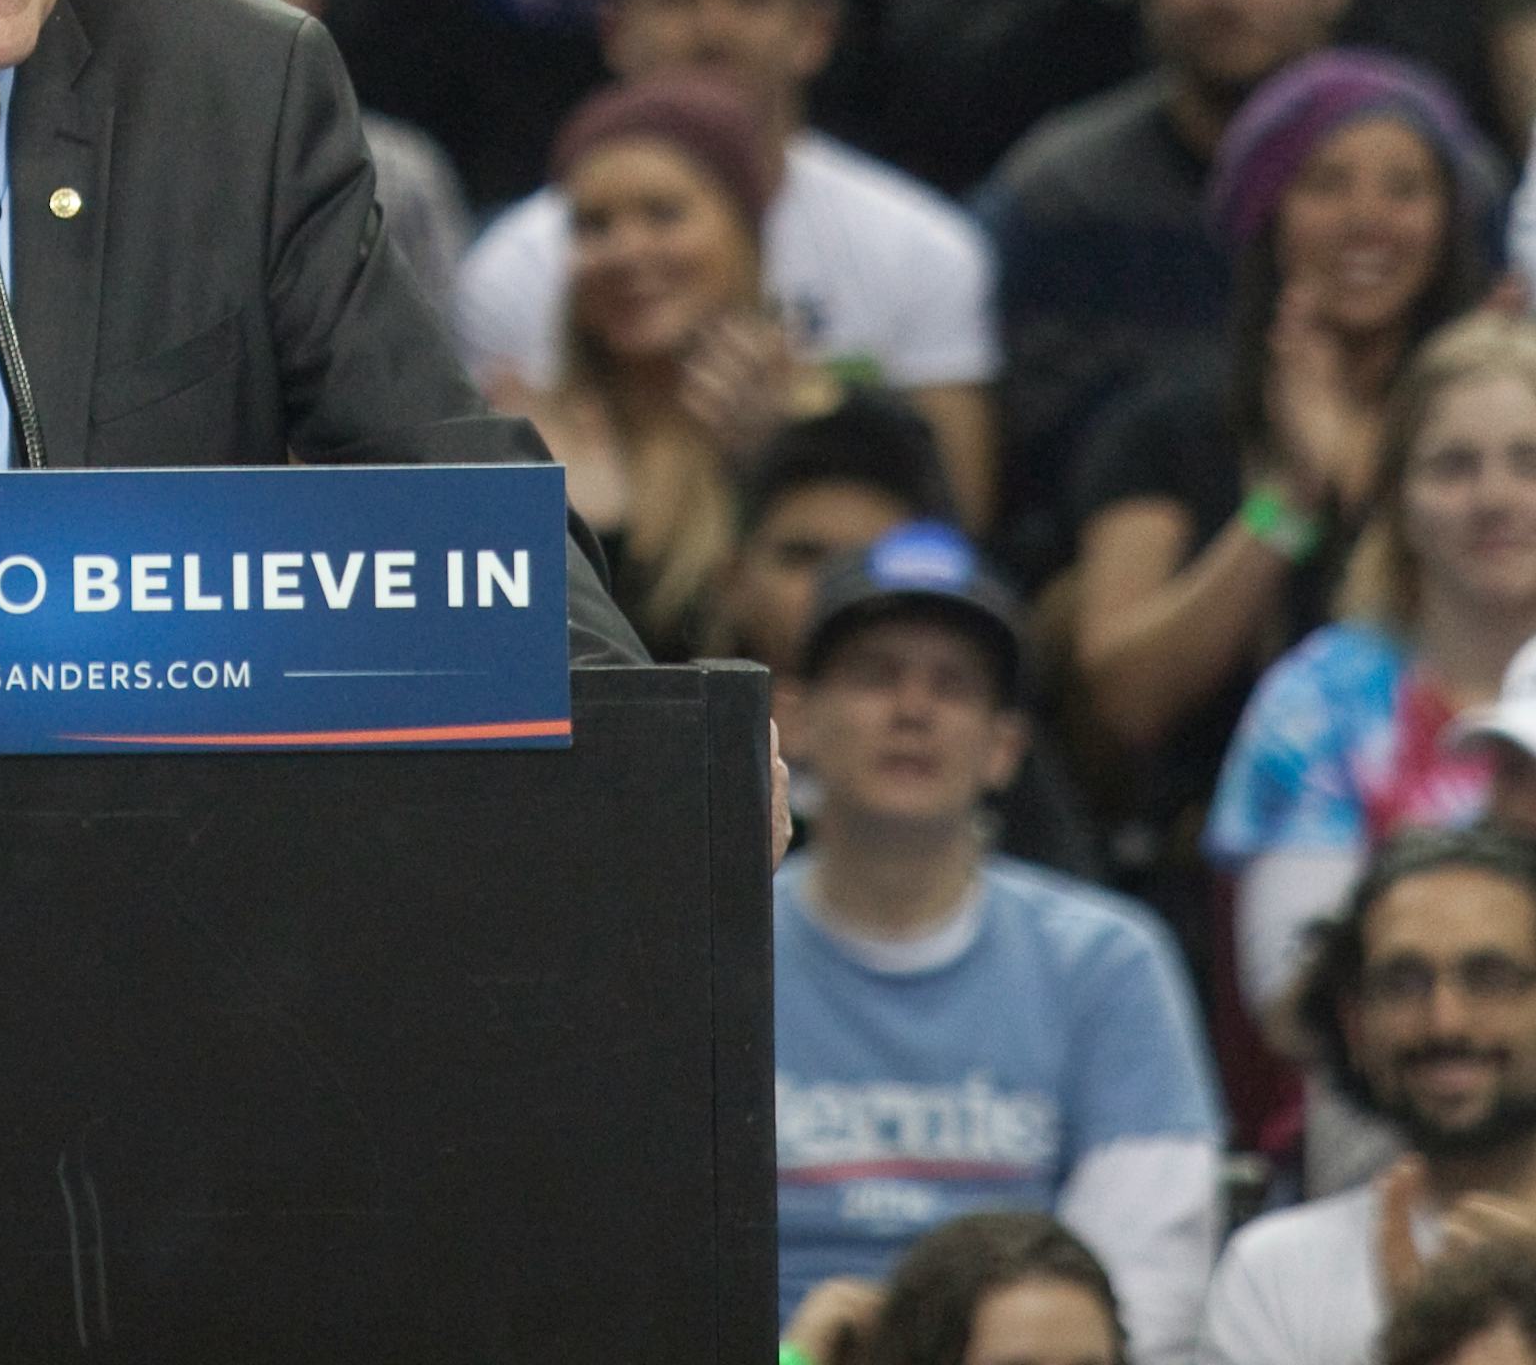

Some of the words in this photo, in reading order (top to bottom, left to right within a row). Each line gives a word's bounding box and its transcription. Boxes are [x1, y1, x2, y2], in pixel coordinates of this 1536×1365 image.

[73, 550, 418, 613] BELIEVE
[446, 549, 531, 608] IN
[776, 1071, 1056, 1164] ernie
